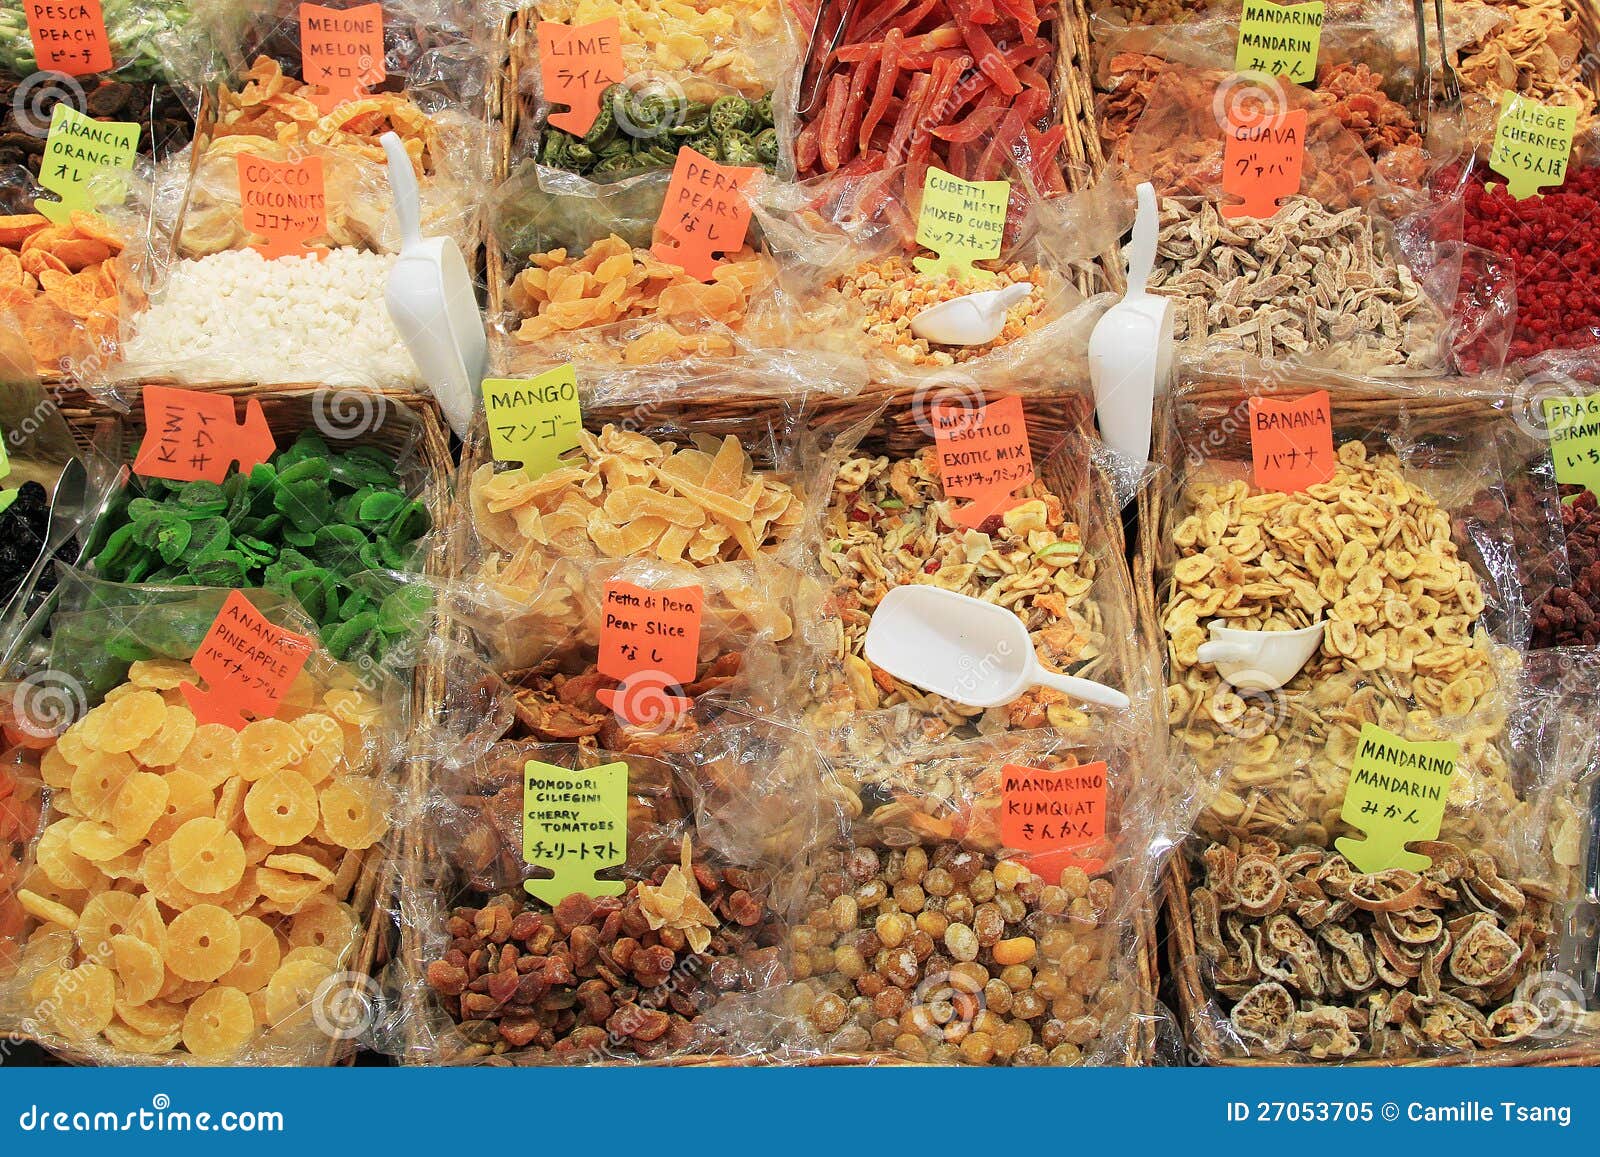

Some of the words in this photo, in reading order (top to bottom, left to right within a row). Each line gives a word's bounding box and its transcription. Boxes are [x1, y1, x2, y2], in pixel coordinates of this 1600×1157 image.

[34, 5, 90, 19] PESCA
[1246, 7, 1322, 27] MANDARINO
[40, 29, 96, 41] PEACH
[308, 17, 374, 33] MELONE
[311, 43, 371, 56] MELON
[551, 36, 611, 56] LIME
[1242, 33, 1311, 53] MANDARIN
[51, 49, 92, 63] ピーチ
[1250, 58, 1304, 76] みかん
[557, 69, 615, 88] ライム
[58, 119, 130, 149] ARANCIA
[1235, 125, 1297, 144] GUAVA
[1502, 125, 1567, 152] CHERRIES
[1500, 146, 1568, 177] さくらんぼ
[246, 165, 310, 186] COCCO
[687, 163, 739, 191] PERA
[930, 177, 985, 200] CUBETTI
[247, 190, 325, 209] COCONUTS
[679, 188, 739, 219] PEARS
[963, 200, 1000, 214] MISTI
[256, 213, 319, 231] ココナッツ
[680, 212, 720, 240] なし
[923, 204, 963, 224] MIXED
[968, 217, 1003, 233] CUBES
[492, 383, 575, 409] MANGO
[497, 415, 577, 443] マンゴー
[940, 412, 985, 429] MISTO
[1257, 407, 1326, 431] BANANA
[158, 405, 185, 463] KIWI
[189, 412, 217, 471] キウイ
[949, 423, 1010, 442] ESOTICO
[943, 450, 991, 466] EXOTIC
[996, 444, 1025, 460] MIX
[1264, 447, 1318, 471] バナナ
[608, 590, 641, 607] Fetta
[644, 594, 656, 609] di
[227, 605, 296, 657] ANANAS
[607, 614, 638, 631] Pear
[645, 621, 685, 638] Slice
[216, 624, 287, 678] PINEAPPLE
[621, 644, 664, 663] なし
[206, 647, 277, 699] パイナップル
[1361, 740, 1453, 775] MANDARINO
[529, 778, 597, 791] POMODORI
[1005, 775, 1103, 792] MANDARINO
[1355, 769, 1441, 800] MANDARIN
[536, 793, 601, 803] CILIEGINI
[528, 811, 580, 821] CHERRY
[1009, 801, 1096, 816] KUMQUAT
[1361, 800, 1419, 824] みかん
[541, 822, 614, 832] TOMATOES
[1022, 822, 1093, 840] きんかん
[531, 842, 619, 860] チェリートマト
